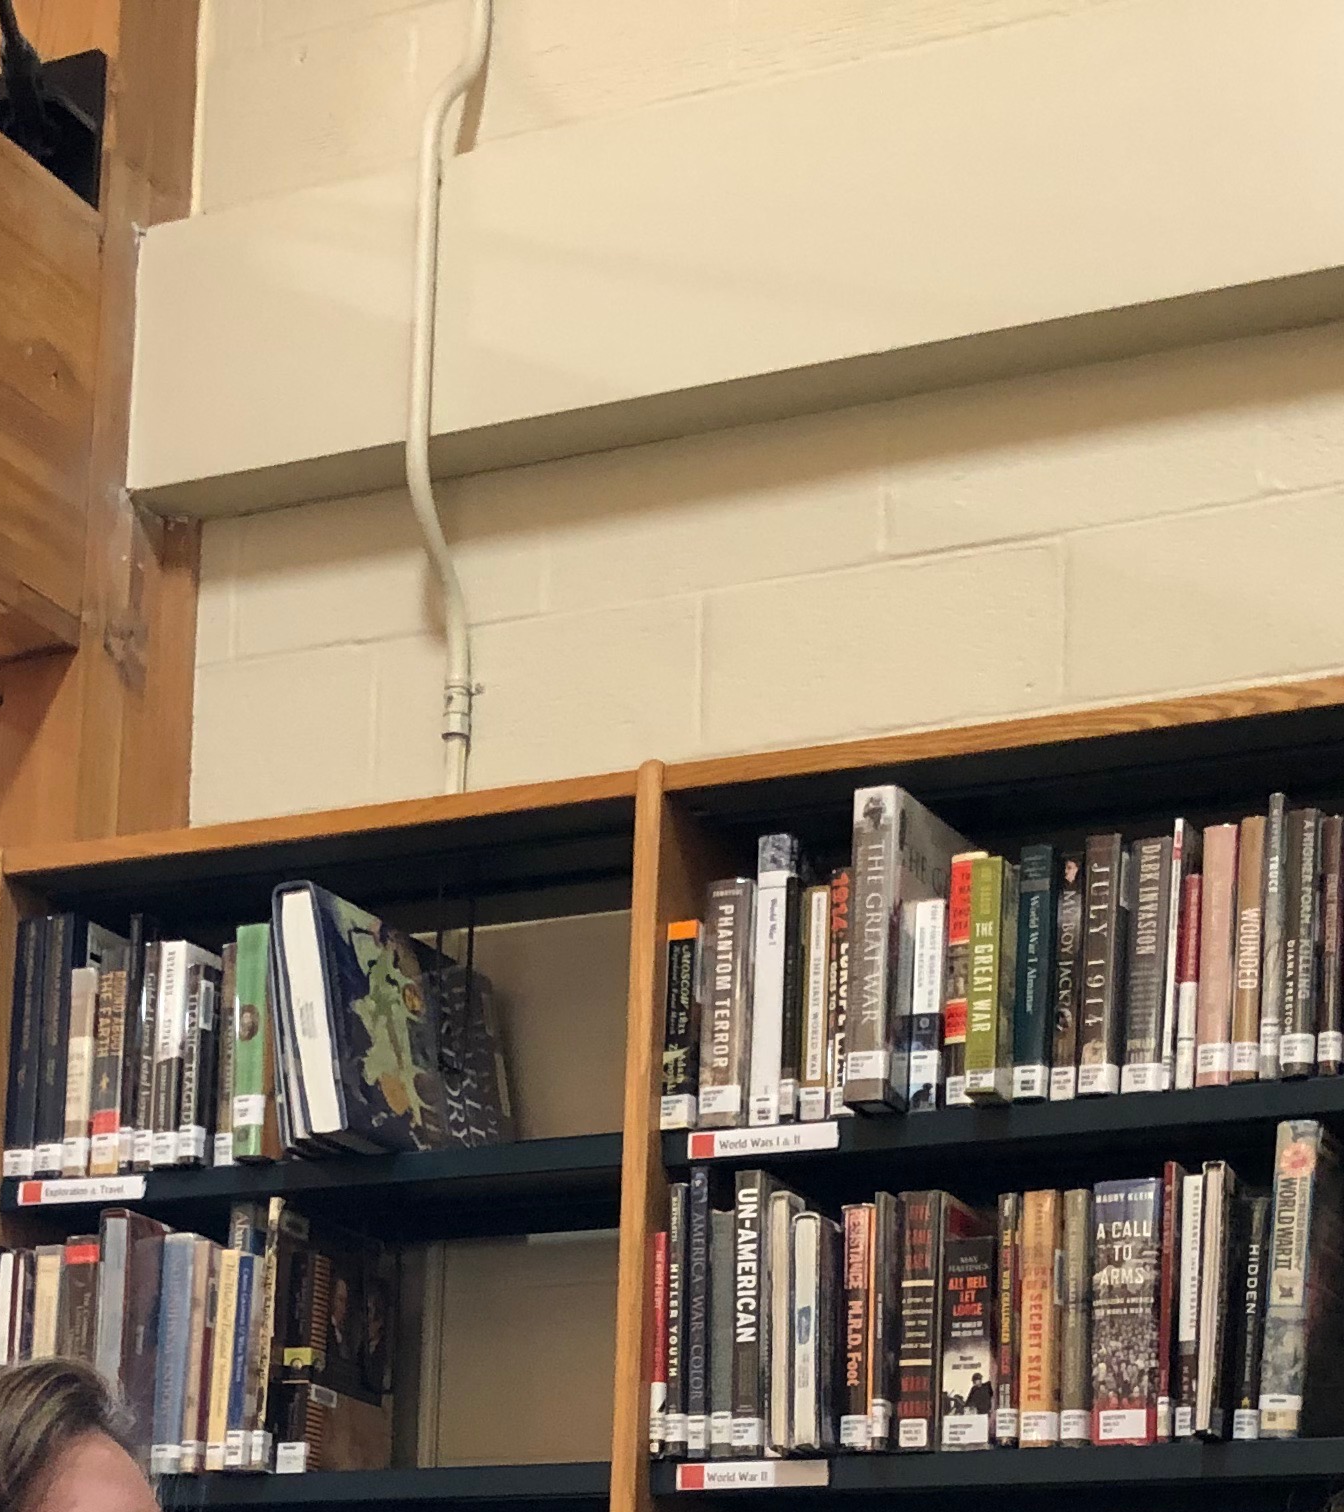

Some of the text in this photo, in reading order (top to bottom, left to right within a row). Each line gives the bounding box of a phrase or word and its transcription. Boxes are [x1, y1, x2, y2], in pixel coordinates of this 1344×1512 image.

[1135, 844, 1162, 955] DARK INVASION
[1267, 855, 1280, 893] TRUCE
[1297, 820, 1315, 999] A HIGHER FORM KILLING
[861, 840, 885, 1025] THE GREAT WAR
[1024, 896, 1042, 1014] World War Almanac
[1060, 921, 1076, 954] BOY
[1084, 863, 1111, 1027] JULY 1914
[1238, 907, 1261, 989] WOUNDED
[97, 972, 113, 1057] THE EARTH
[681, 945, 691, 1008] MOSCOW
[712, 904, 735, 1068] PHANTOM TERROR
[810, 957, 821, 1075] THE WORLD WAR
[971, 943, 994, 1033] GREAT WAR
[1282, 940, 1296, 1034] DIANA PRESTON
[719, 1138, 749, 1150] World
[752, 1137, 773, 1148] Wars
[100, 1184, 124, 1194] Travel
[1096, 1220, 1151, 1239] A CALL
[1275, 1177, 1298, 1270] WORLD WAR II
[736, 1188, 757, 1343] UN-AMERICAN
[847, 1208, 866, 1289] RESISTANCE
[1001, 1271, 1011, 1291] WHO
[1100, 1268, 1145, 1286] ARMS
[1113, 1244, 1132, 1262] TO
[1188, 1185, 1200, 1330] RESISTANCE BETRAYAL
[1245, 1244, 1260, 1315] HIDDEN
[667, 1263, 679, 1378] HITLER YOUTH
[691, 1212, 705, 1401] AMERICA WAR COLOR
[959, 1290, 976, 1303] LET
[847, 1301, 864, 1387] M.R.D. Foot
[1026, 1294, 1043, 1401] SECRET STATE
[707, 1470, 735, 1483] World
[738, 1471, 758, 1482] War
